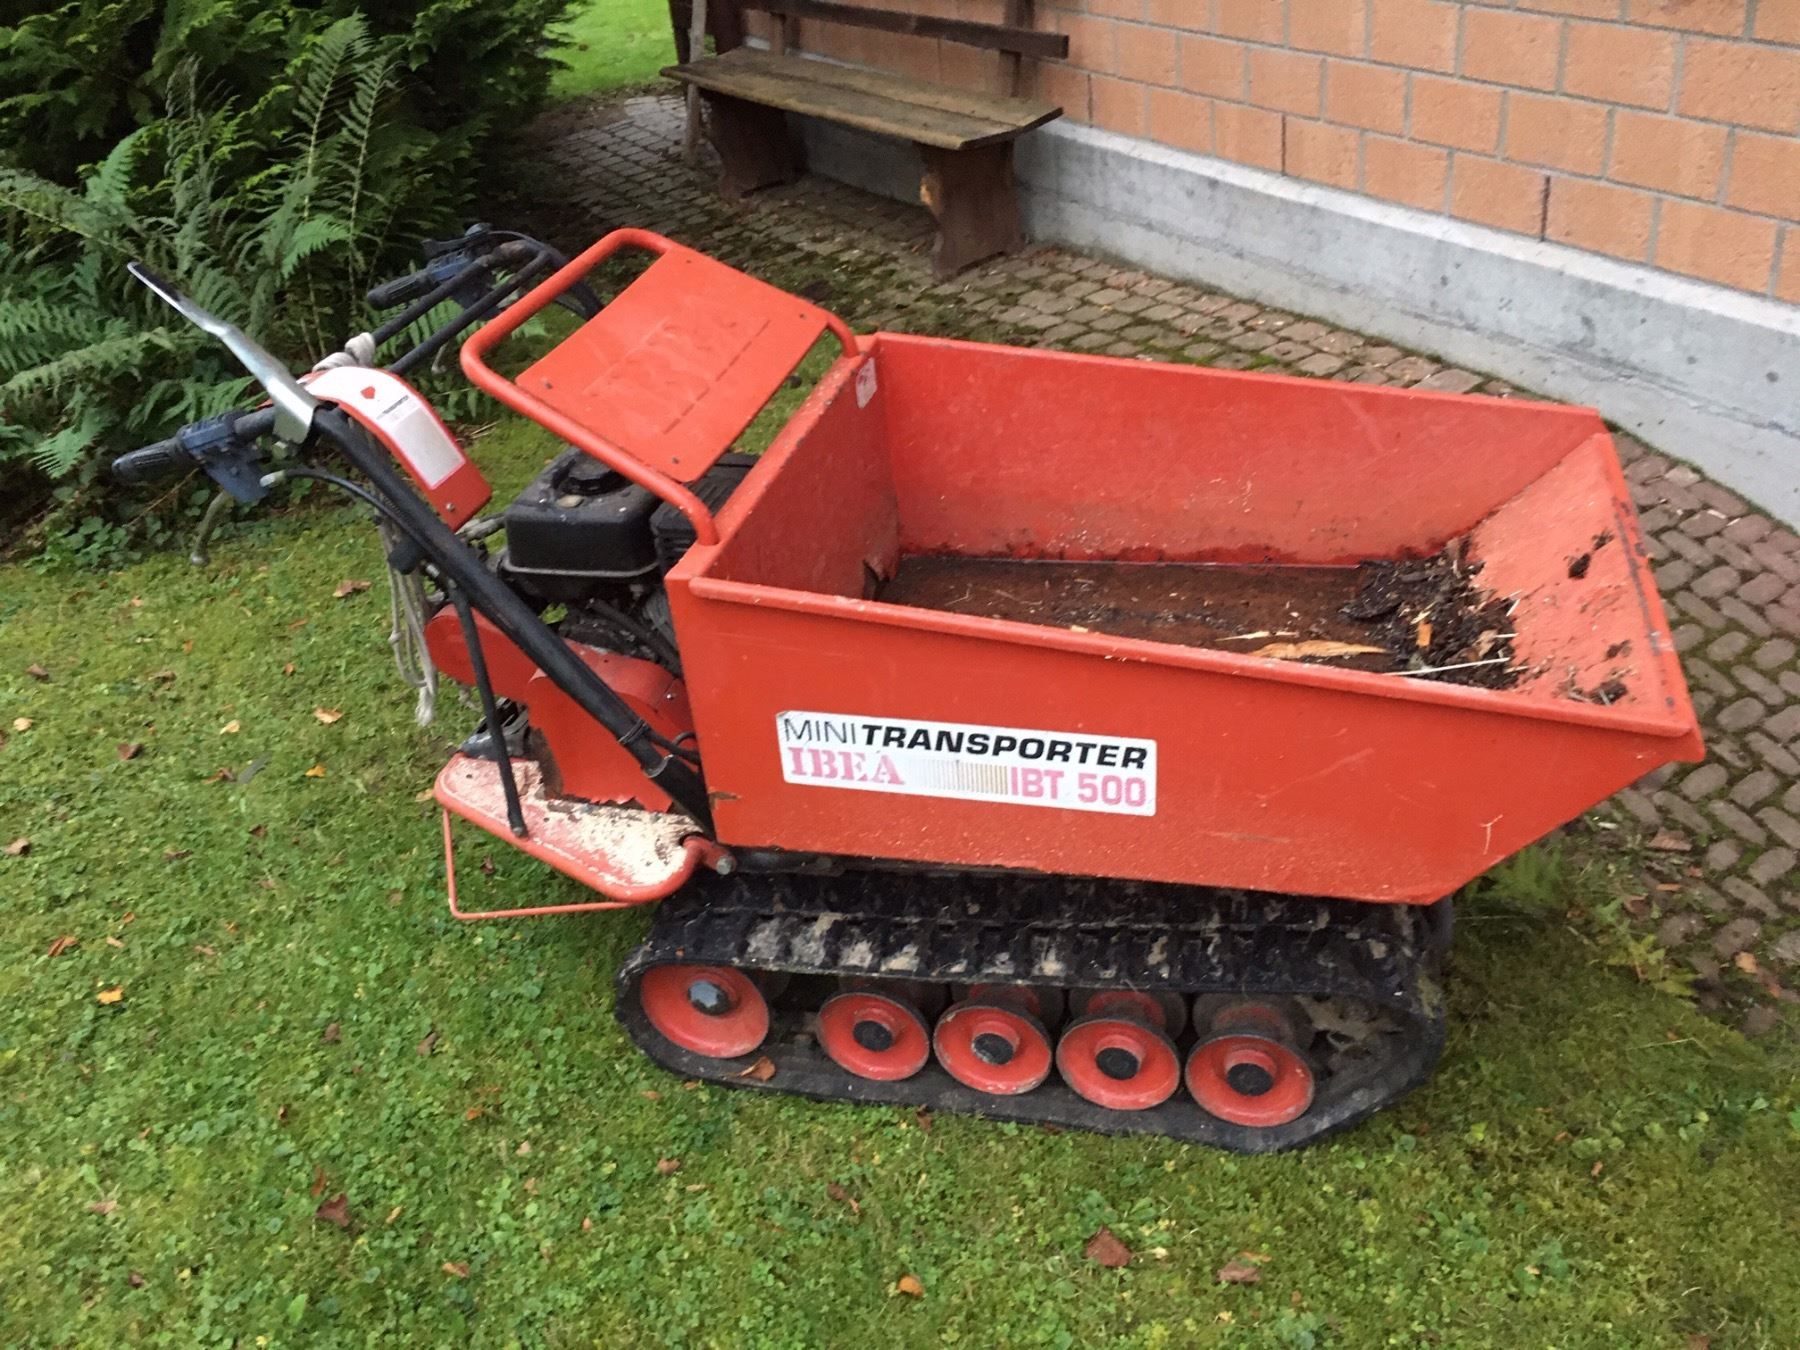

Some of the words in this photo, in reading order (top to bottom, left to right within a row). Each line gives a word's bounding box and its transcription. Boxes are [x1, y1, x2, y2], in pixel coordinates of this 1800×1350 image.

[787, 747, 905, 786] IBEA
[1011, 768, 1064, 800] IBT
[1077, 773, 1147, 808] 500
